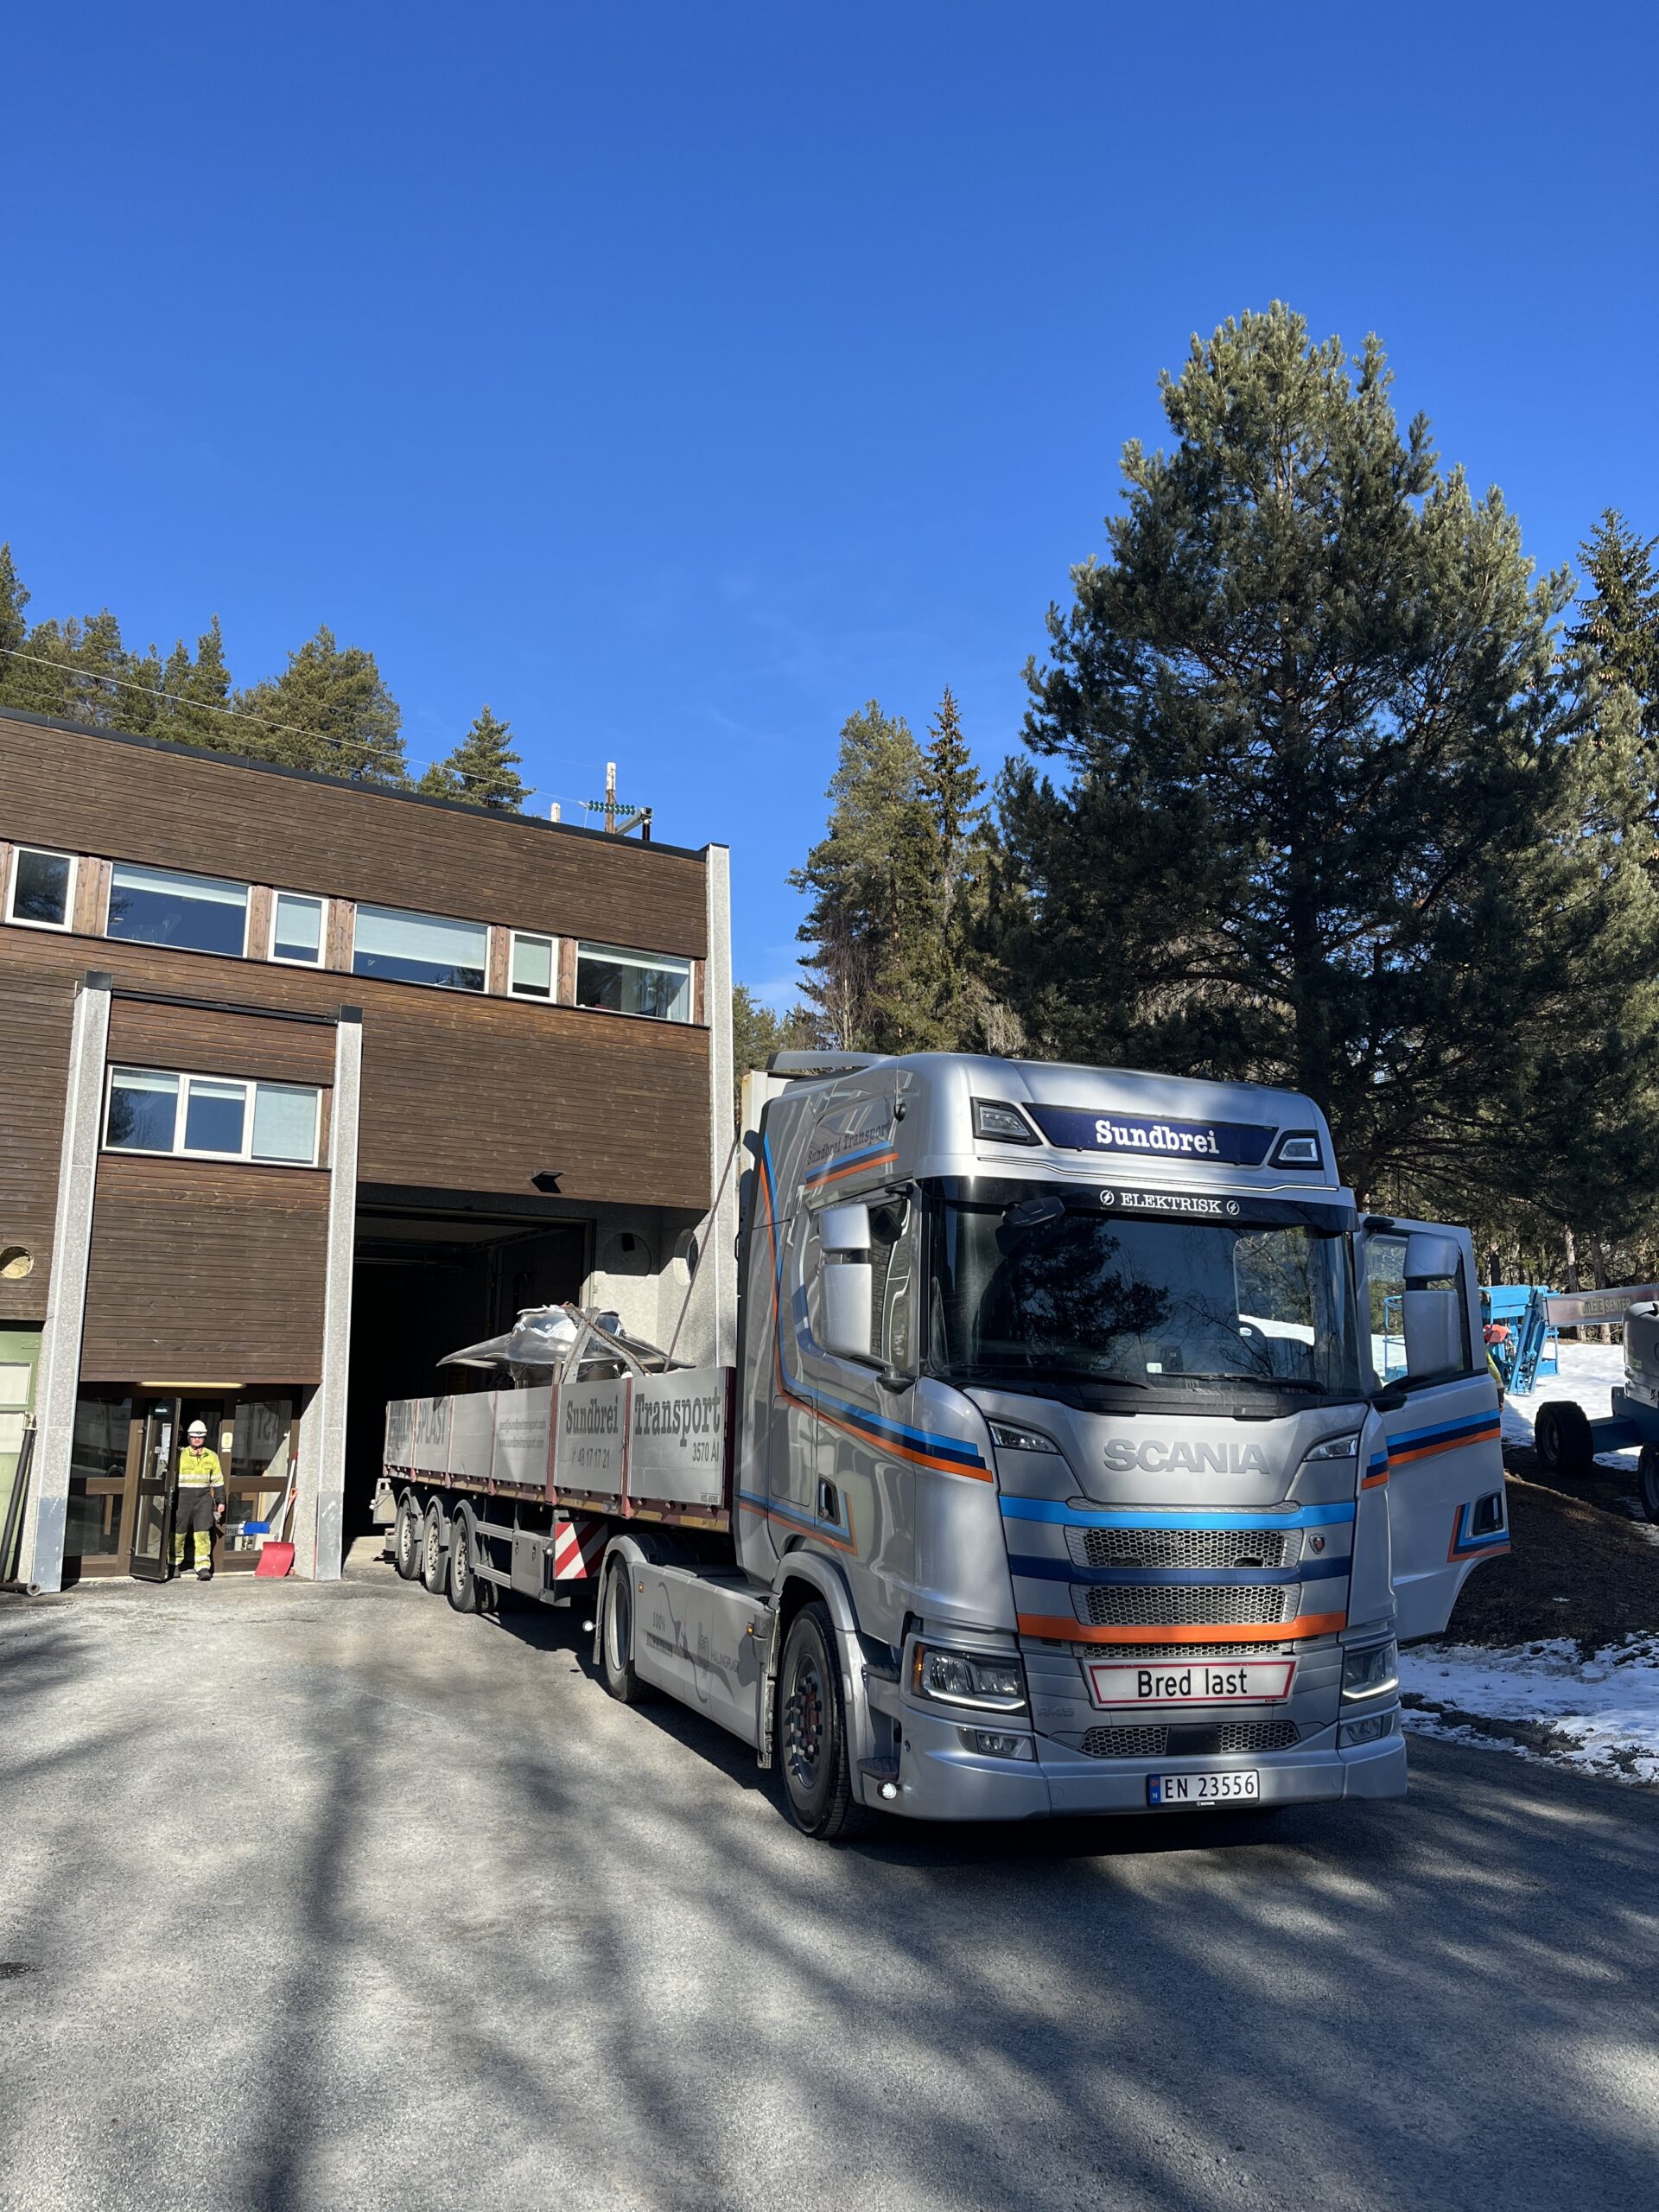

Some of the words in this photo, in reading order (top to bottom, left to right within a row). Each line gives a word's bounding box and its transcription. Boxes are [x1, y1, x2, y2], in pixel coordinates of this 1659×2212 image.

[807, 1135, 842, 1165] Sundbrei
[843, 1120, 893, 1150] Transport
[1095, 1120, 1220, 1154] Sundbrei
[1120, 1192, 1223, 1213] ELEKTRISK
[566, 1395, 619, 1434] Sundbrei
[634, 1386, 721, 1447] Transport
[692, 1441, 709, 1462] 3570
[1103, 1438, 1270, 1474] SCANIA
[1137, 1669, 1192, 1698] Bred
[1205, 1668, 1248, 1694] last
[1165, 1778, 1188, 1799] EN
[1198, 1775, 1254, 1797] 23556
